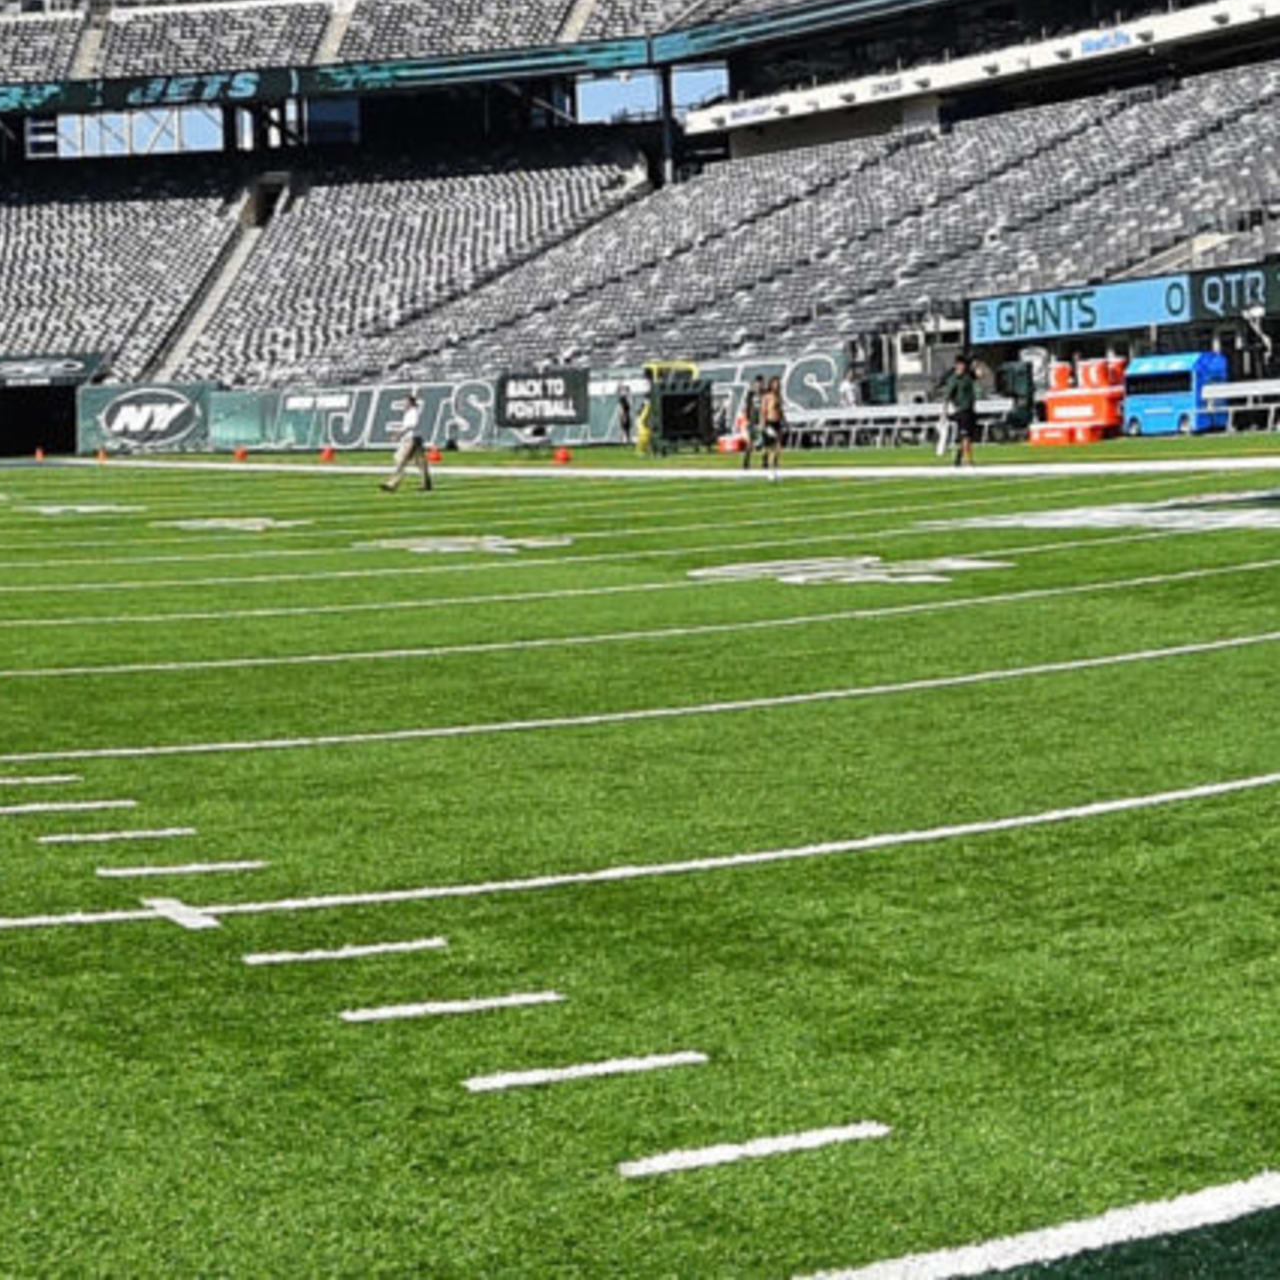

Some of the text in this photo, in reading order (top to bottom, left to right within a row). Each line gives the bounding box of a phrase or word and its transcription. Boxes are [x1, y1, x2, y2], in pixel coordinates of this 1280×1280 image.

[127, 71, 260, 105] JETS
[1203, 270, 1266, 315] QTR
[996, 292, 1098, 336] GIANTS
[506, 378, 565, 398] BACK TO
[109, 402, 190, 432] NY
[328, 380, 495, 448] JETS
[505, 398, 576, 419] FOOTBALL
